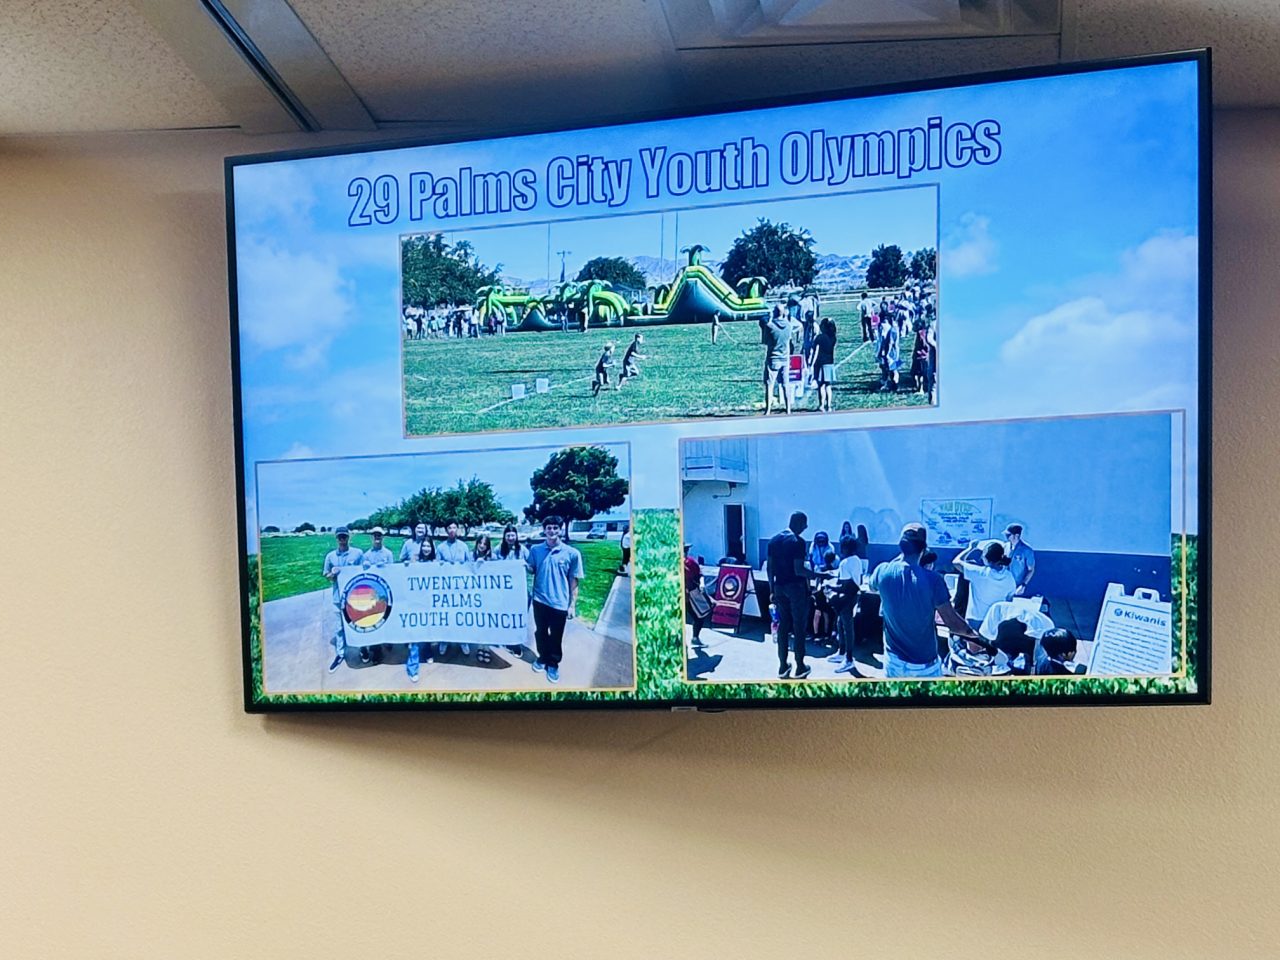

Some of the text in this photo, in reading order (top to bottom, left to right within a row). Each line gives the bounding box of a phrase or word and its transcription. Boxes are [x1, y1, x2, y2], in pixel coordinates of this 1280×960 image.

[348, 116, 1002, 226] 29 Palms City Youth Olympics
[407, 574, 513, 591] TWENTYNINE
[432, 593, 483, 608] PALMS
[399, 611, 526, 629] YOUTH COUNCIL
[1124, 610, 1167, 627] Kiwanis
